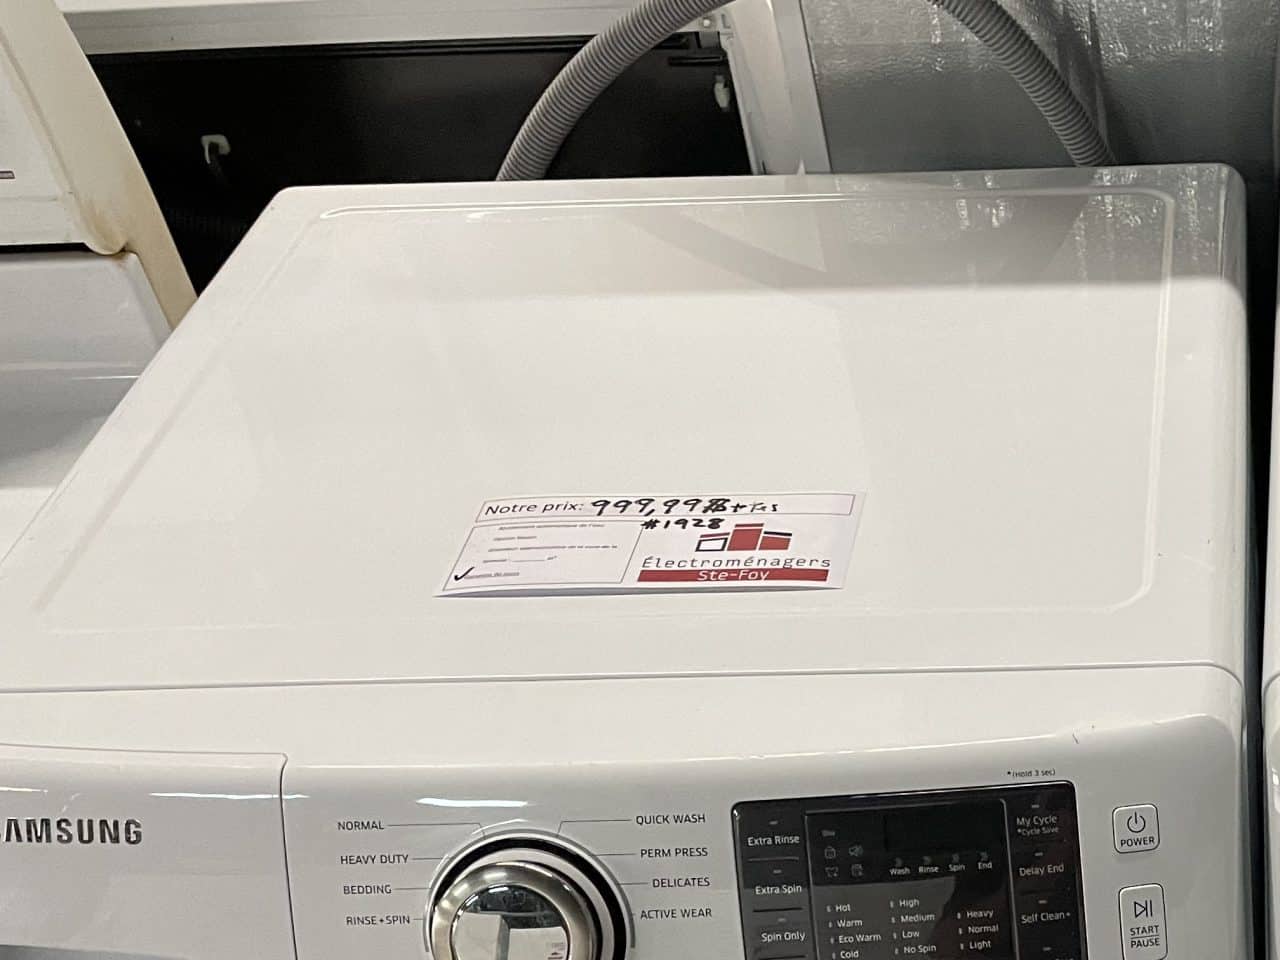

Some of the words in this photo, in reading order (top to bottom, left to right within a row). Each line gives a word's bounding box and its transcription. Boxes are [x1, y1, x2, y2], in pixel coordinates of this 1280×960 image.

[484, 500, 537, 516] Notre
[543, 500, 585, 516] prix:
[641, 517, 726, 531] #1928
[641, 555, 832, 570] Électroménagers
[698, 568, 771, 583] Ste-Foy
[337, 820, 385, 831] NORMAL
[635, 814, 671, 826] QUICK
[673, 813, 706, 825] WASH
[1016, 815, 1032, 827] My
[1033, 814, 1058, 826] Cycle
[0, 818, 143, 845] AMSUNG
[747, 836, 772, 847] Extra
[775, 834, 800, 846] Rinse
[1120, 836, 1155, 848] POWER
[640, 847, 672, 859] PERM
[675, 846, 709, 858] PRESS
[340, 854, 376, 865] HEAVY
[379, 853, 409, 864] DUTY
[977, 861, 993, 871] End
[1019, 865, 1046, 877] Delay
[1047, 863, 1065, 874] End
[651, 876, 711, 888] DELICATES
[343, 884, 392, 895] BEDDING
[755, 885, 780, 896] Extra
[781, 884, 803, 896] Spin
[835, 903, 851, 913] Hot
[899, 898, 920, 910] High
[640, 908, 676, 920] ACTIVE
[679, 907, 713, 919] WEAR
[900, 912, 936, 923] Medium
[966, 909, 994, 920] Heavy
[837, 919, 863, 929] Warm
[968, 923, 999, 934] Normal
[761, 932, 783, 943] Spin
[784, 930, 806, 943] Only
[902, 930, 920, 939] Low
[1129, 925, 1160, 936] START
[838, 935, 854, 944] Eco
[855, 933, 882, 943] Warm
[969, 939, 992, 950] Light
[1130, 938, 1161, 949] PAUSE
[840, 949, 860, 960] Cold
[903, 945, 917, 954] No
[918, 944, 938, 955] Spin
